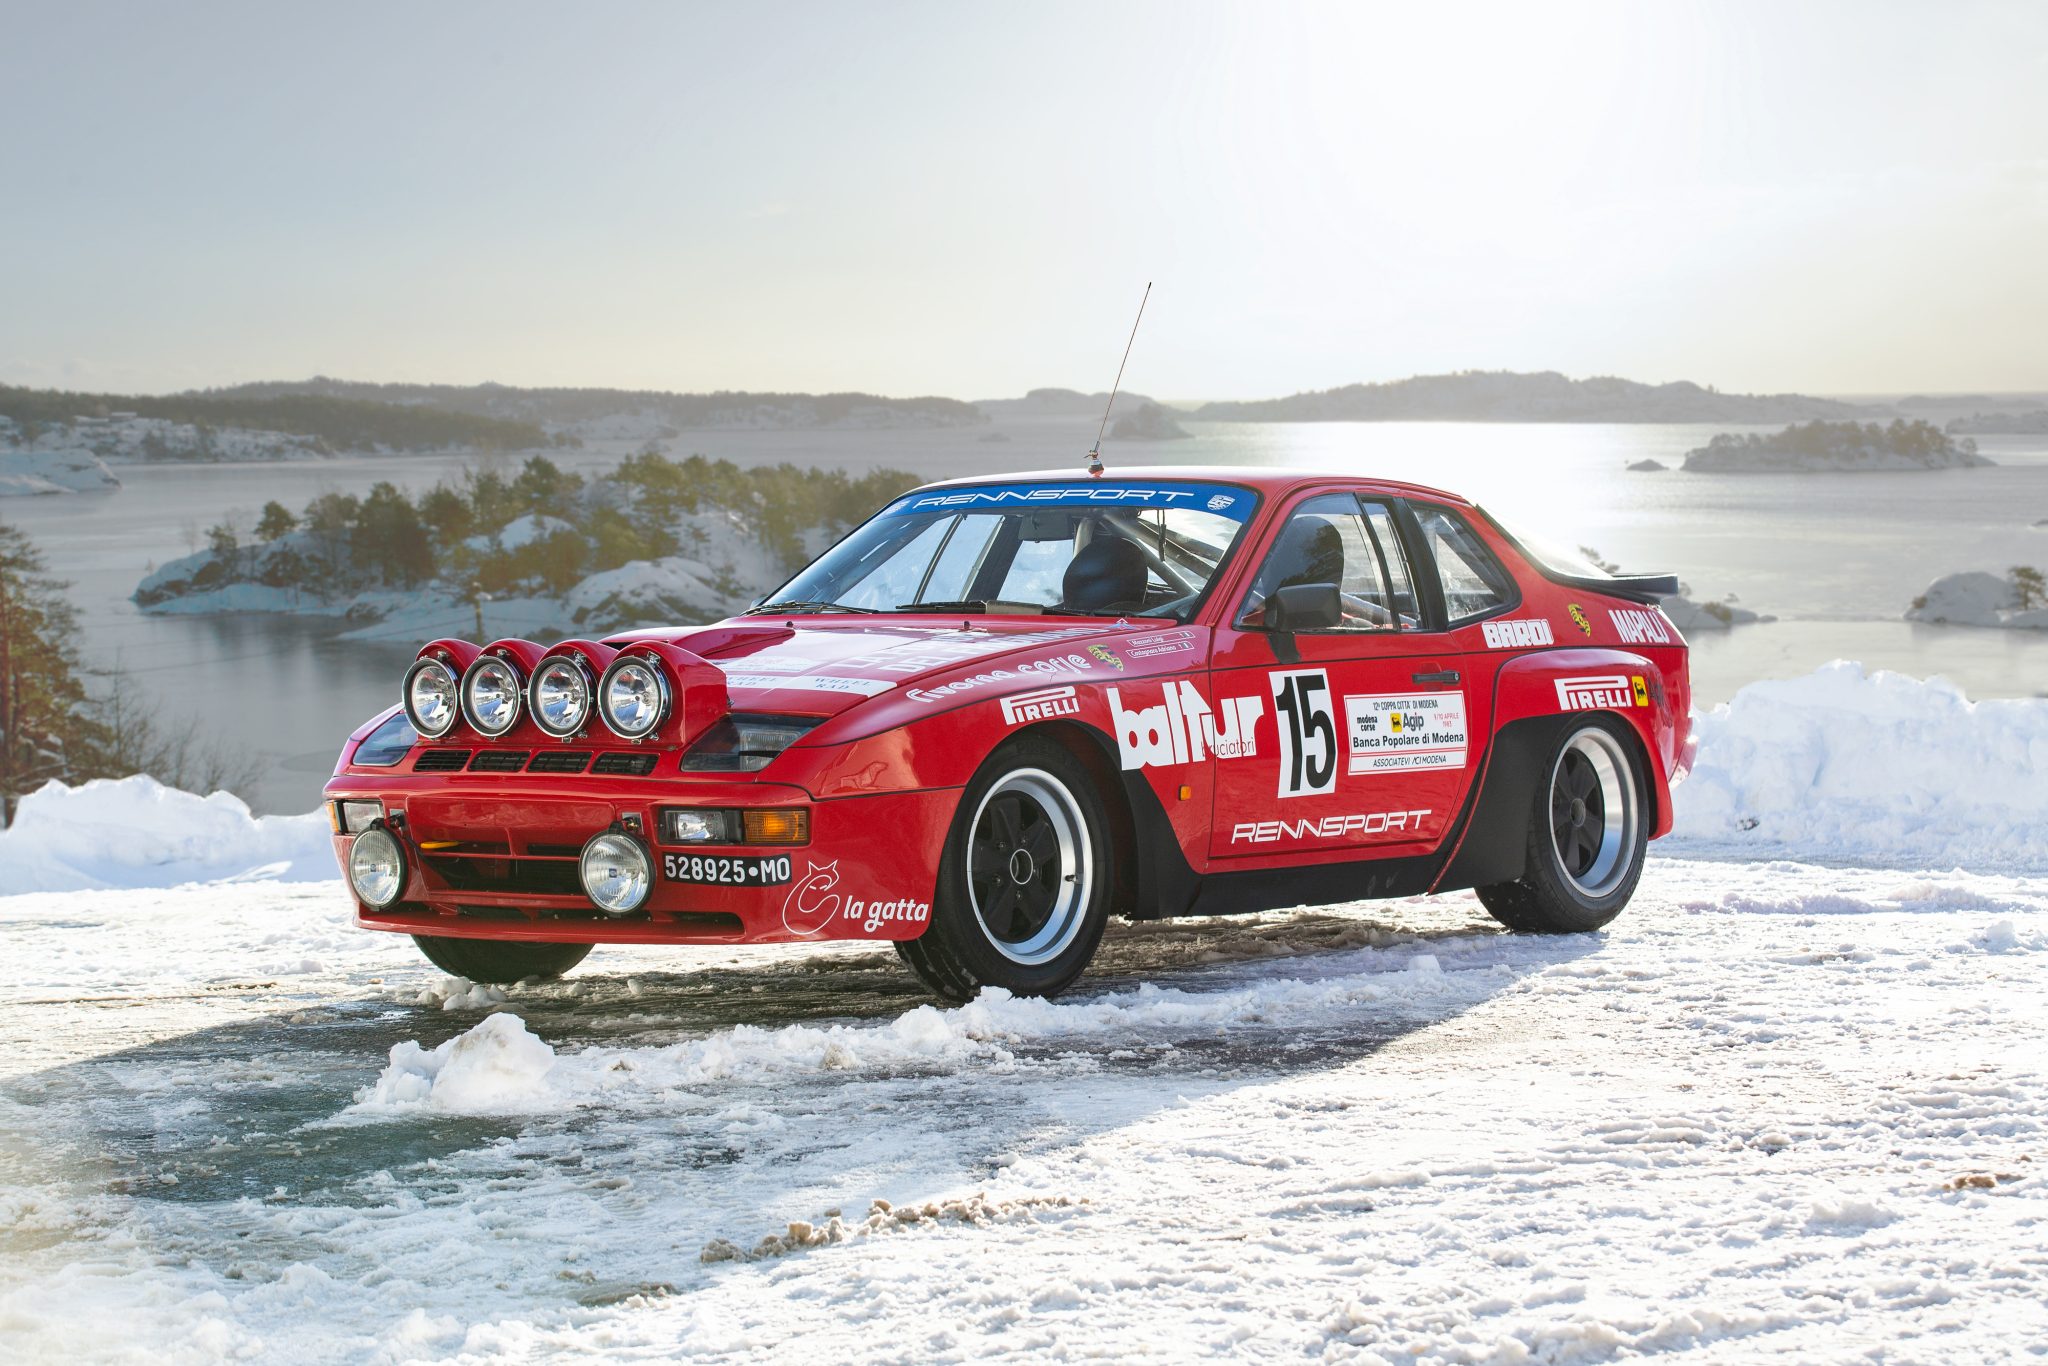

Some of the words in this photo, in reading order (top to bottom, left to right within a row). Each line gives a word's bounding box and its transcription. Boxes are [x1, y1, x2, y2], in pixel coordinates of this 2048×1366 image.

[913, 489, 1194, 509] RENNSPORT
[815, 677, 871, 687] WHEEL
[1554, 675, 1632, 711] PIRELLI
[1000, 686, 1080, 726] PIRELLI
[1381, 701, 1397, 711] COPPA
[1412, 700, 1419, 709] DI
[1419, 699, 1439, 709] MODENA
[1356, 714, 1378, 724] modena
[1360, 723, 1376, 732] corse
[1402, 712, 1424, 731] Agip
[1275, 674, 1336, 792] 15
[1353, 737, 1381, 748] Banca
[1383, 734, 1420, 748] Popolare
[1422, 733, 1430, 744] di
[1432, 732, 1464, 744] Modena
[1372, 757, 1411, 768] ASSOCIATEVI
[1422, 755, 1447, 764] MODENA
[1231, 809, 1432, 844] RENNSPORT
[843, 895, 861, 919] la
[864, 899, 929, 933] gatta
